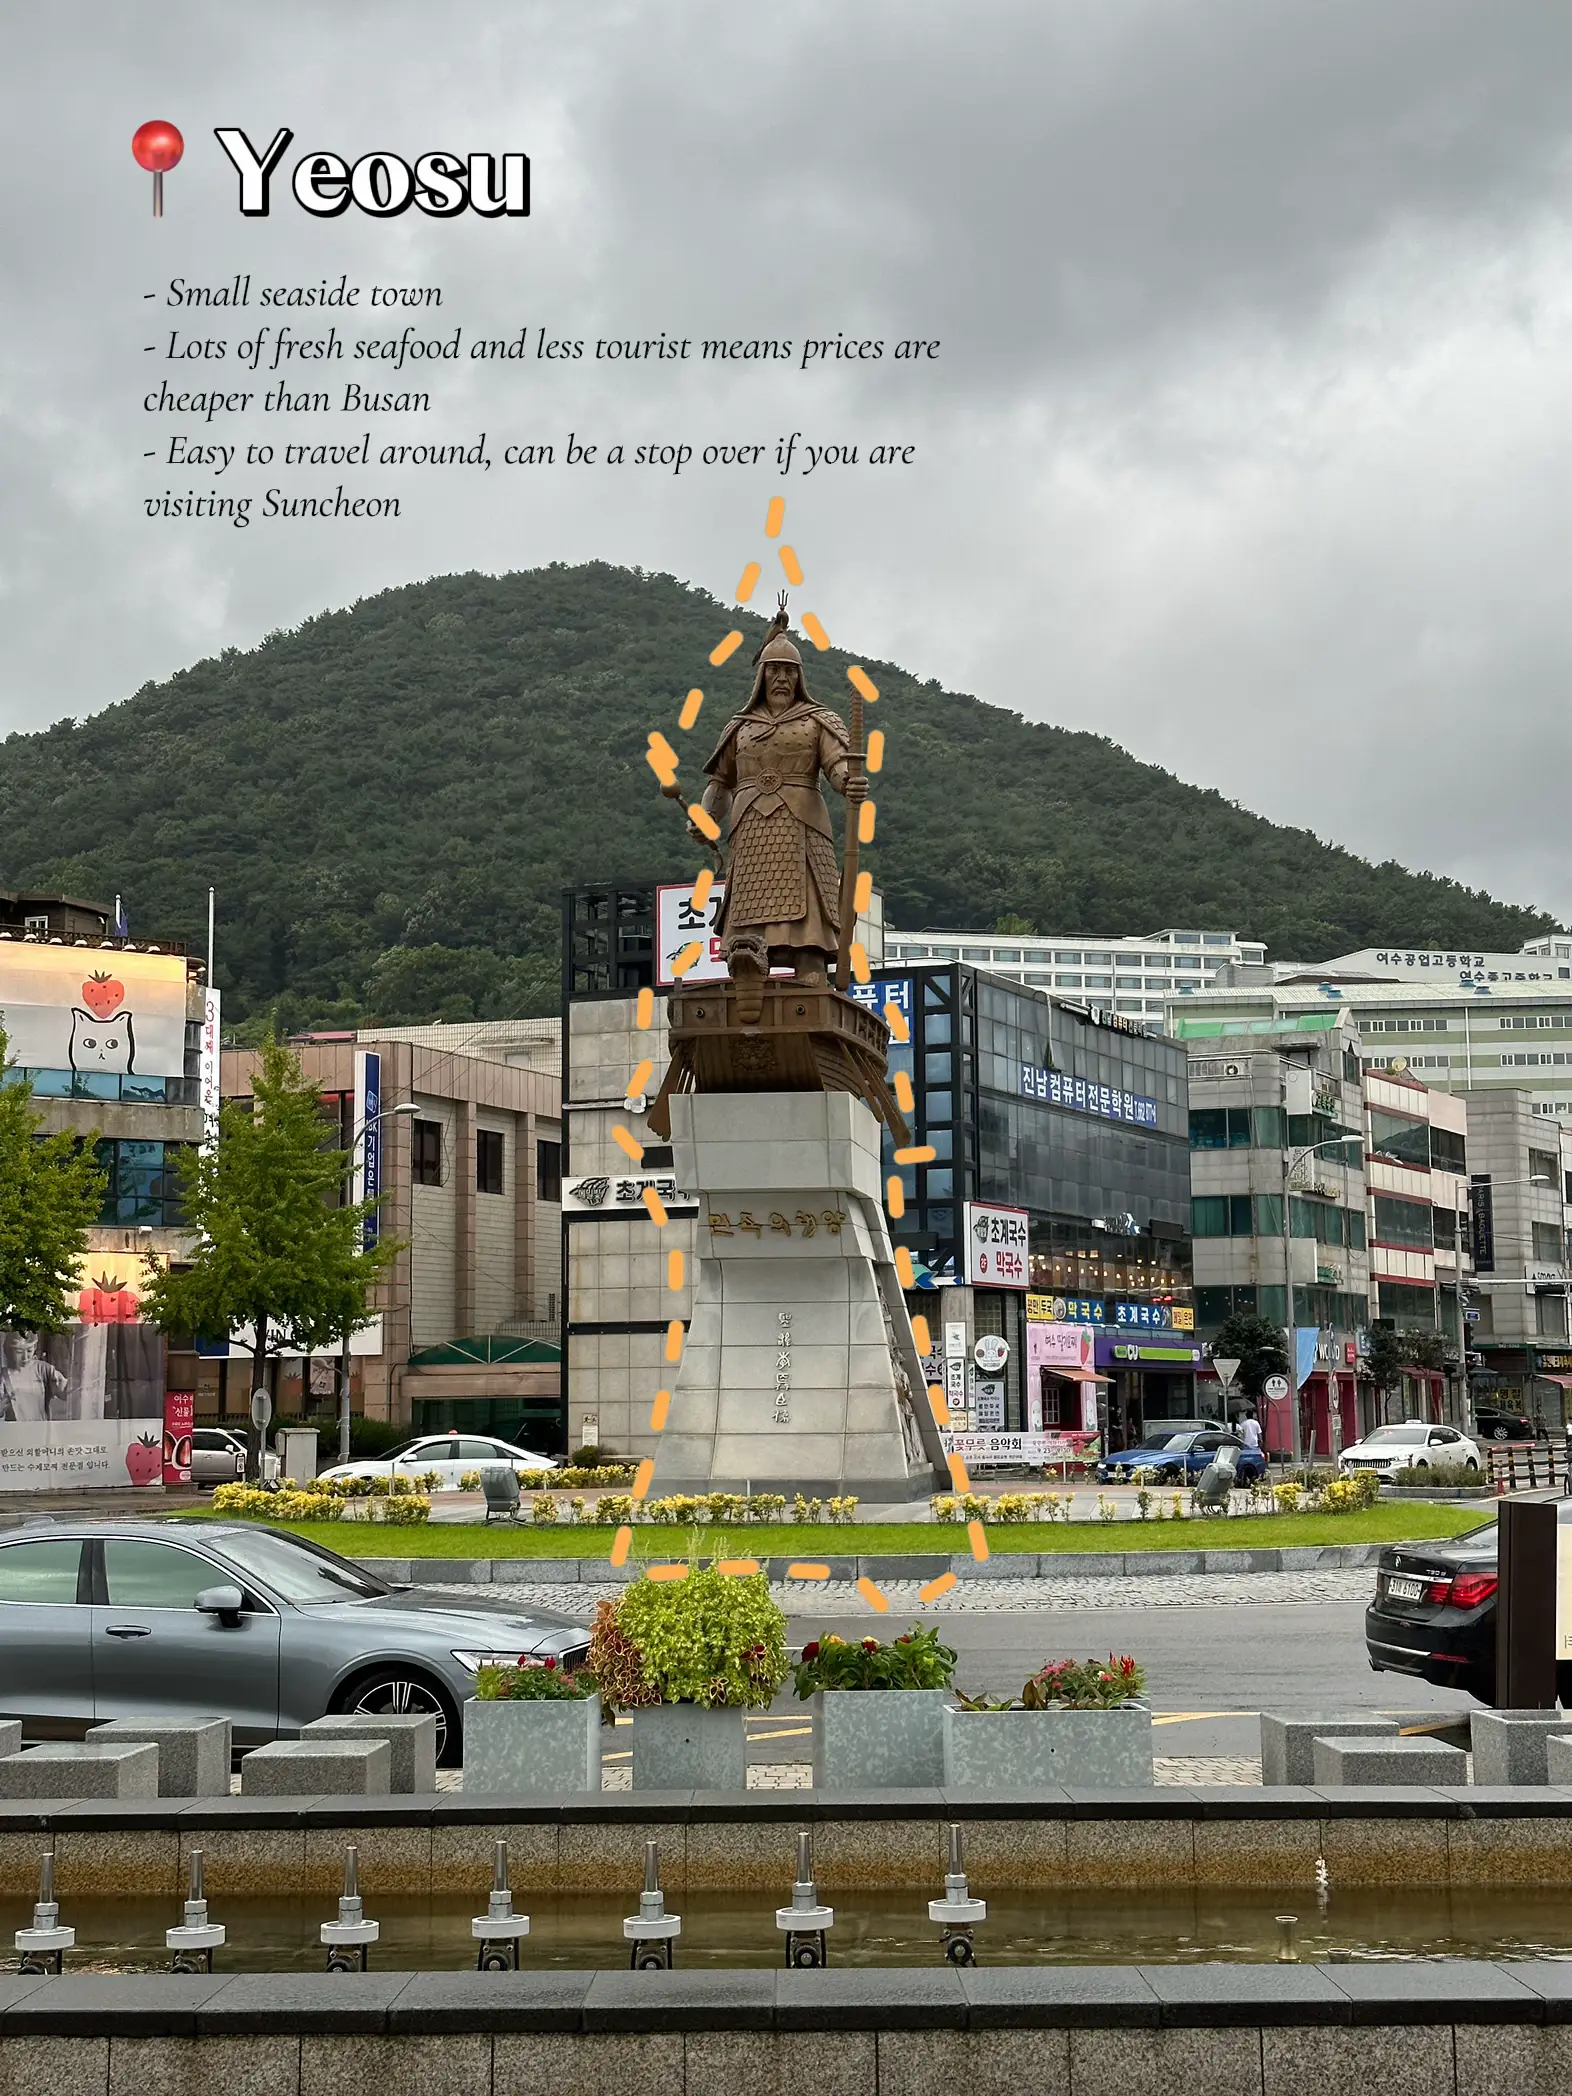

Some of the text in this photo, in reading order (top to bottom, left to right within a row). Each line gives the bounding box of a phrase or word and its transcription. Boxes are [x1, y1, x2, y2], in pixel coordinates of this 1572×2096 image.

[1375, 952, 1485, 968] 여수공업고등학교
[1022, 1065, 1134, 1121] 진남컴퓨터전문학원
[991, 1216, 1027, 1248] 초계국수
[996, 1250, 1024, 1280] 막국수
[1068, 1301, 1103, 1321] 막국수
[1117, 1304, 1161, 1326] 초계국수
[1127, 1344, 1139, 1361] CU
[26, 1447, 65, 1457] 외할머니의
[84, 1445, 108, 1455] 그대로
[989, 1437, 1023, 1452] 음악회
[2, 1463, 25, 1473] 만드는
